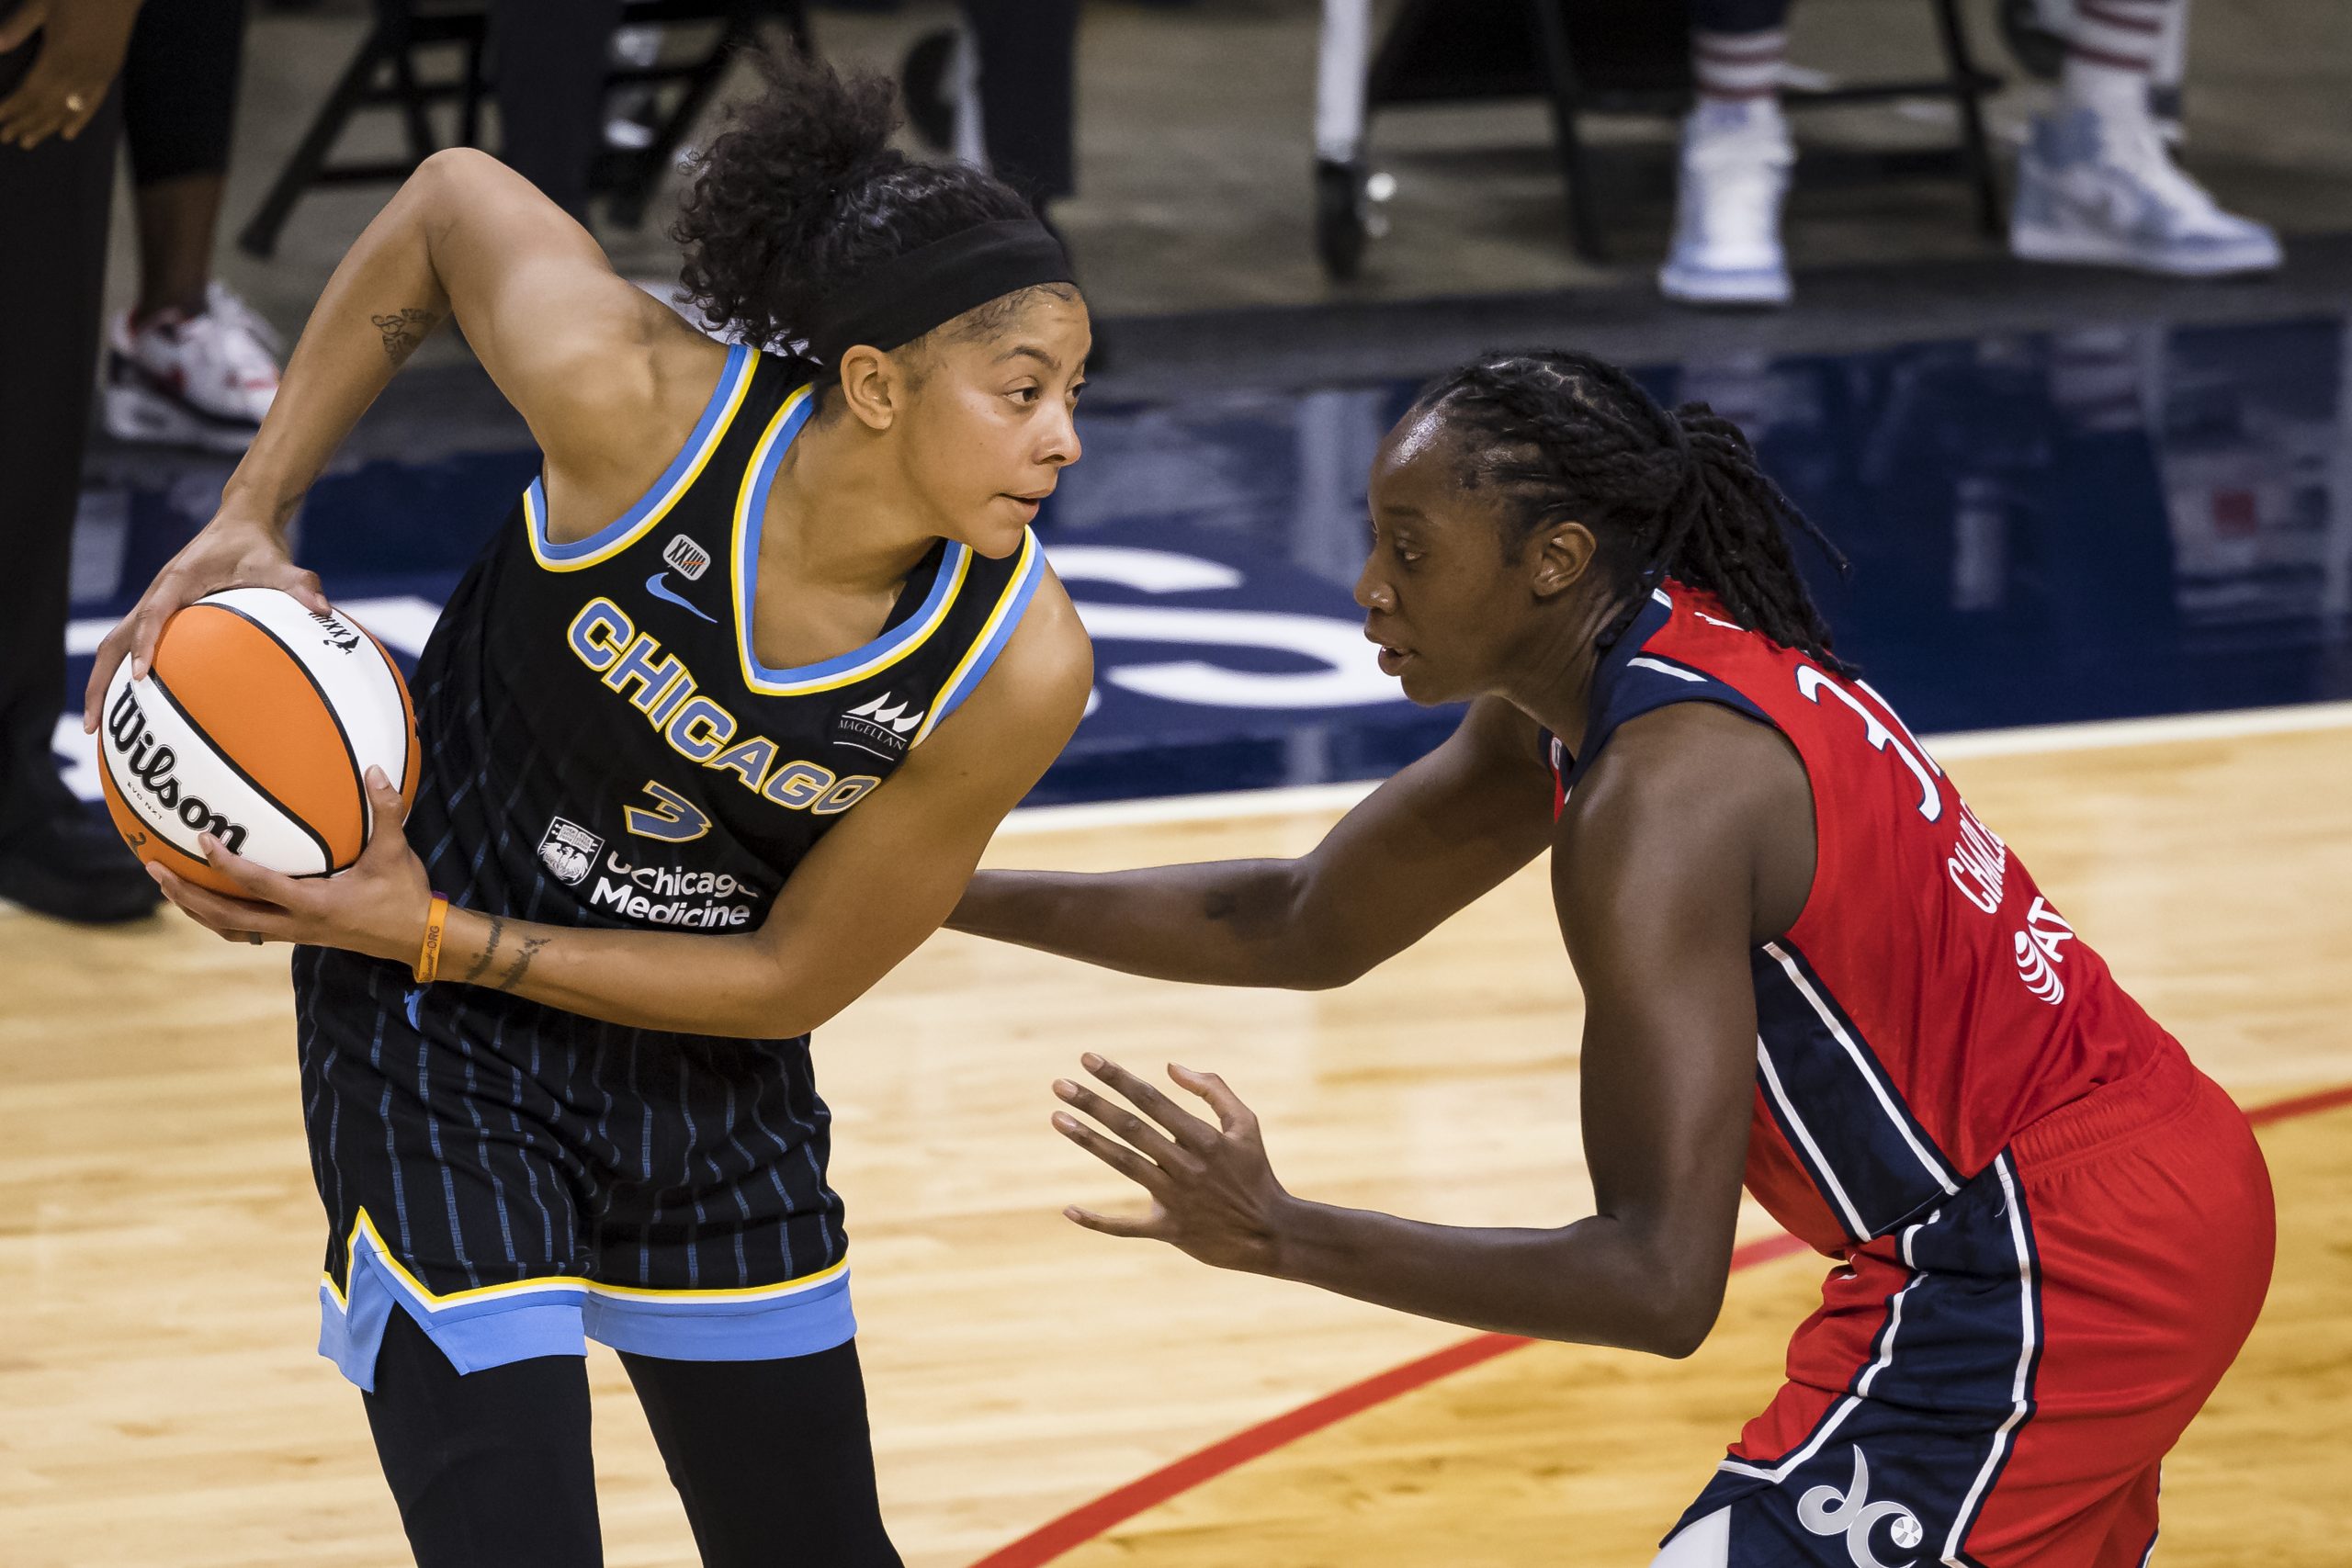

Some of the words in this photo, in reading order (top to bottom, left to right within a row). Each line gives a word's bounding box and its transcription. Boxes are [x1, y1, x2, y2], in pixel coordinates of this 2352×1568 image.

[567, 596, 882, 816] CHICAGO
[838, 719, 906, 750] MAGELLAN
[108, 680, 250, 854] Wilson
[623, 779, 713, 843] 3
[1948, 797, 2006, 915] CHARLE
[589, 876, 751, 928] Medicine
